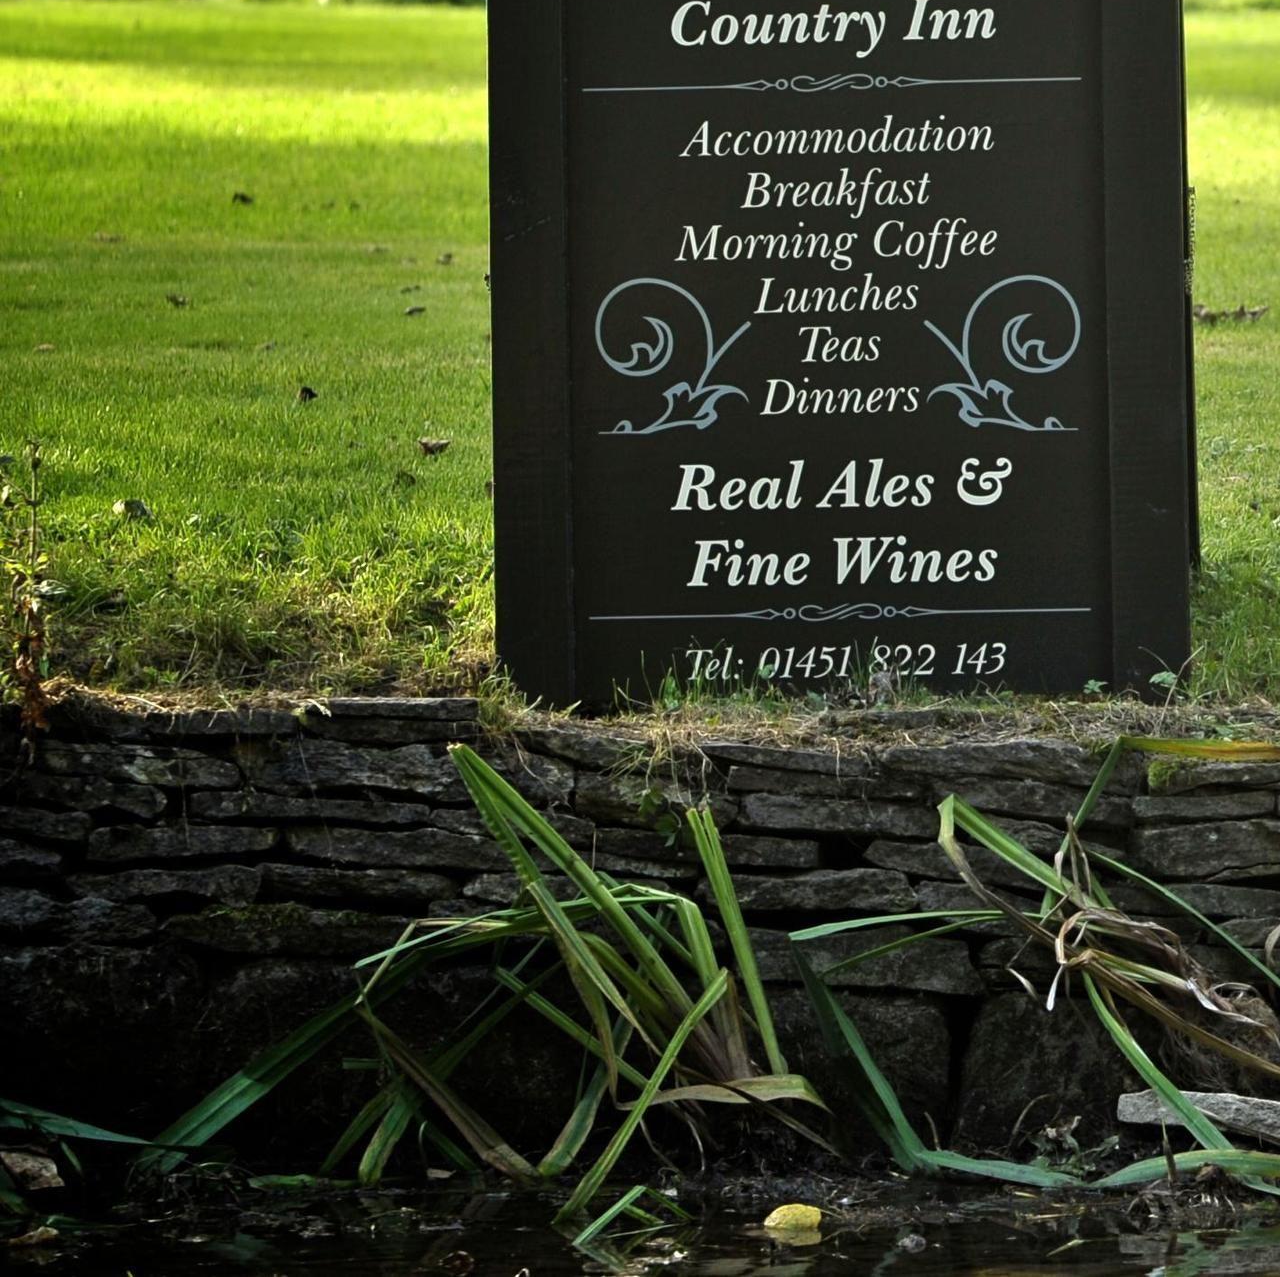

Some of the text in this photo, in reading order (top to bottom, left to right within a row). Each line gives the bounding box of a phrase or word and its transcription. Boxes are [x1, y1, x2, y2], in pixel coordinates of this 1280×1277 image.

[670, 0, 887, 59] Country
[678, 114, 995, 158] Accommodation
[740, 167, 931, 219] Breakfast
[674, 217, 998, 272] Morning Coffee
[753, 272, 920, 315] Lunches
[798, 325, 881, 364] Teas
[759, 376, 920, 416] Dinners
[670, 456, 1013, 511] Real Ales &
[686, 534, 998, 587] Fine Wines
[685, 641, 1007, 681] Tel: 01451 822 143
